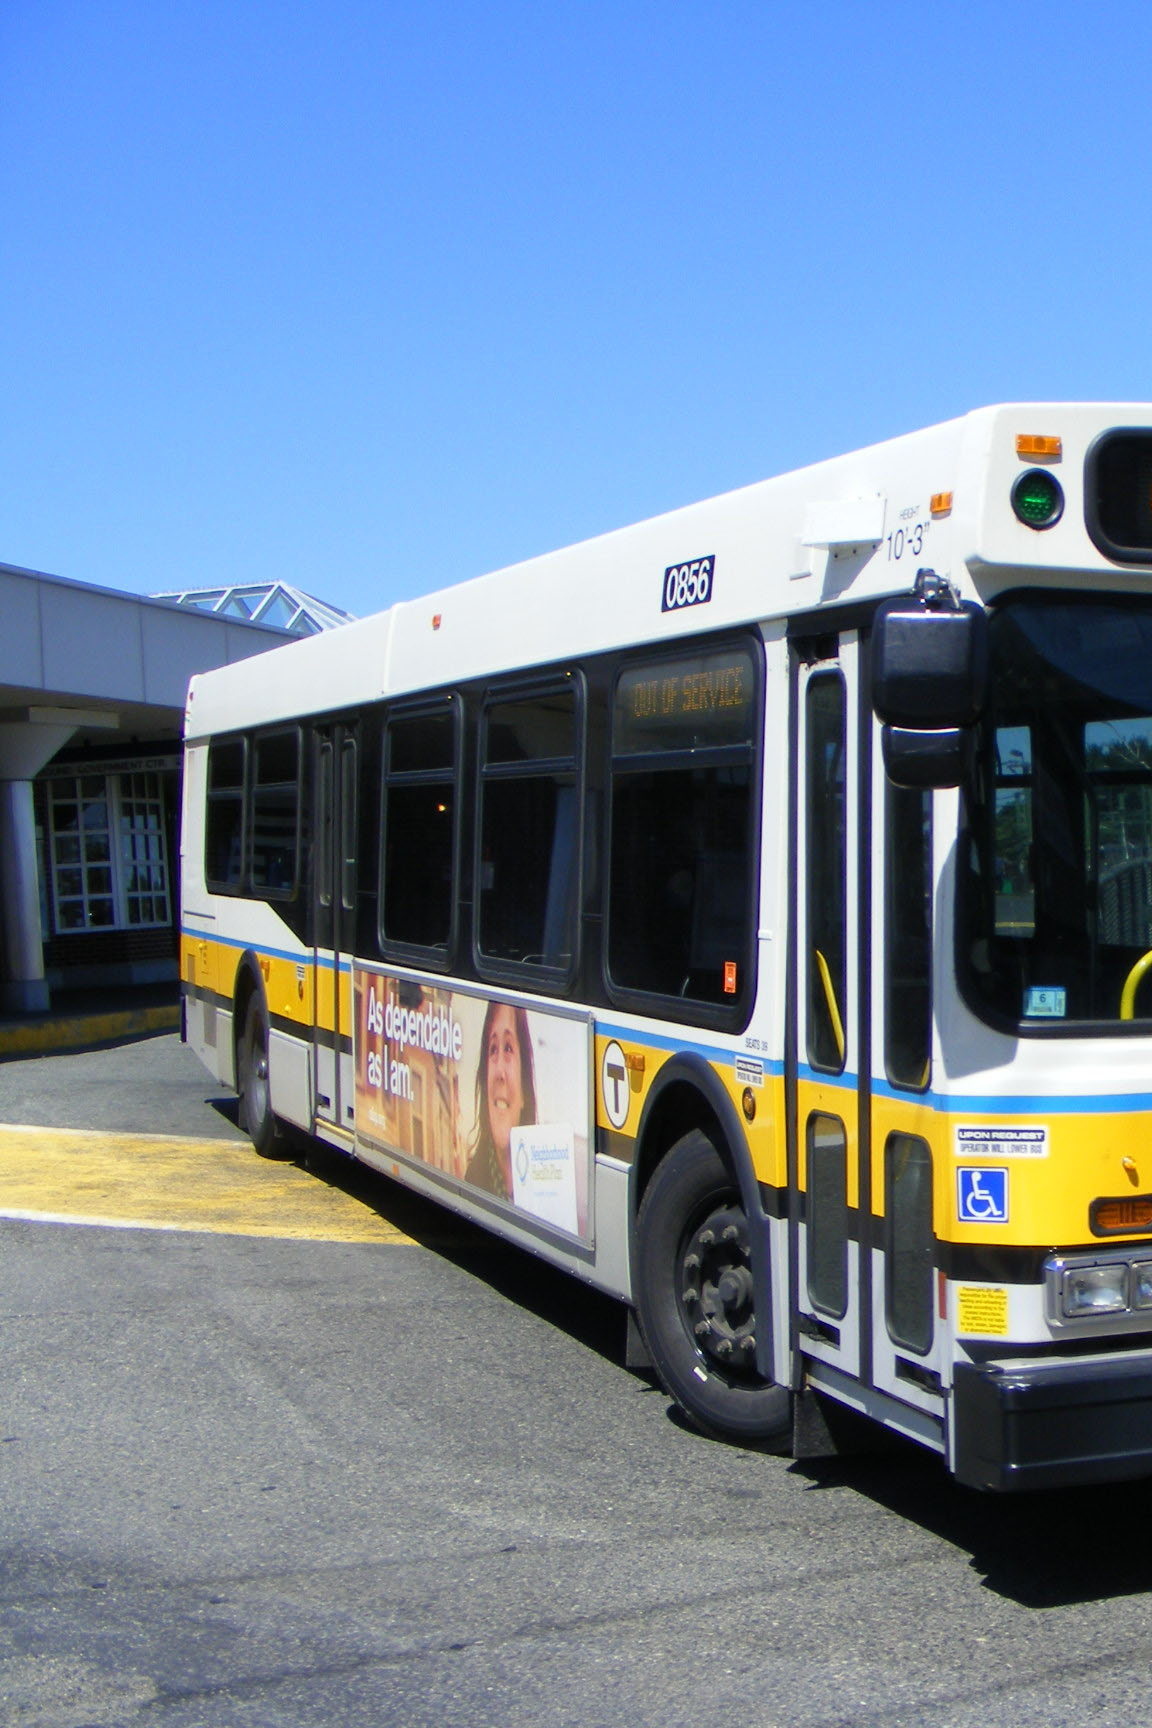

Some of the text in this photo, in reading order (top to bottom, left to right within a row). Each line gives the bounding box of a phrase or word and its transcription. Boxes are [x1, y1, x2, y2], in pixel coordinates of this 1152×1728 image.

[664, 558, 711, 609] 0856
[633, 666, 744, 718] OUT OF SERVICE
[368, 986, 462, 1060] As dependable
[1039, 993, 1047, 1003] 6
[368, 1044, 414, 1101] as I am.
[606, 1062, 625, 1115] T
[959, 1131, 1043, 1140] UPON REQUEST
